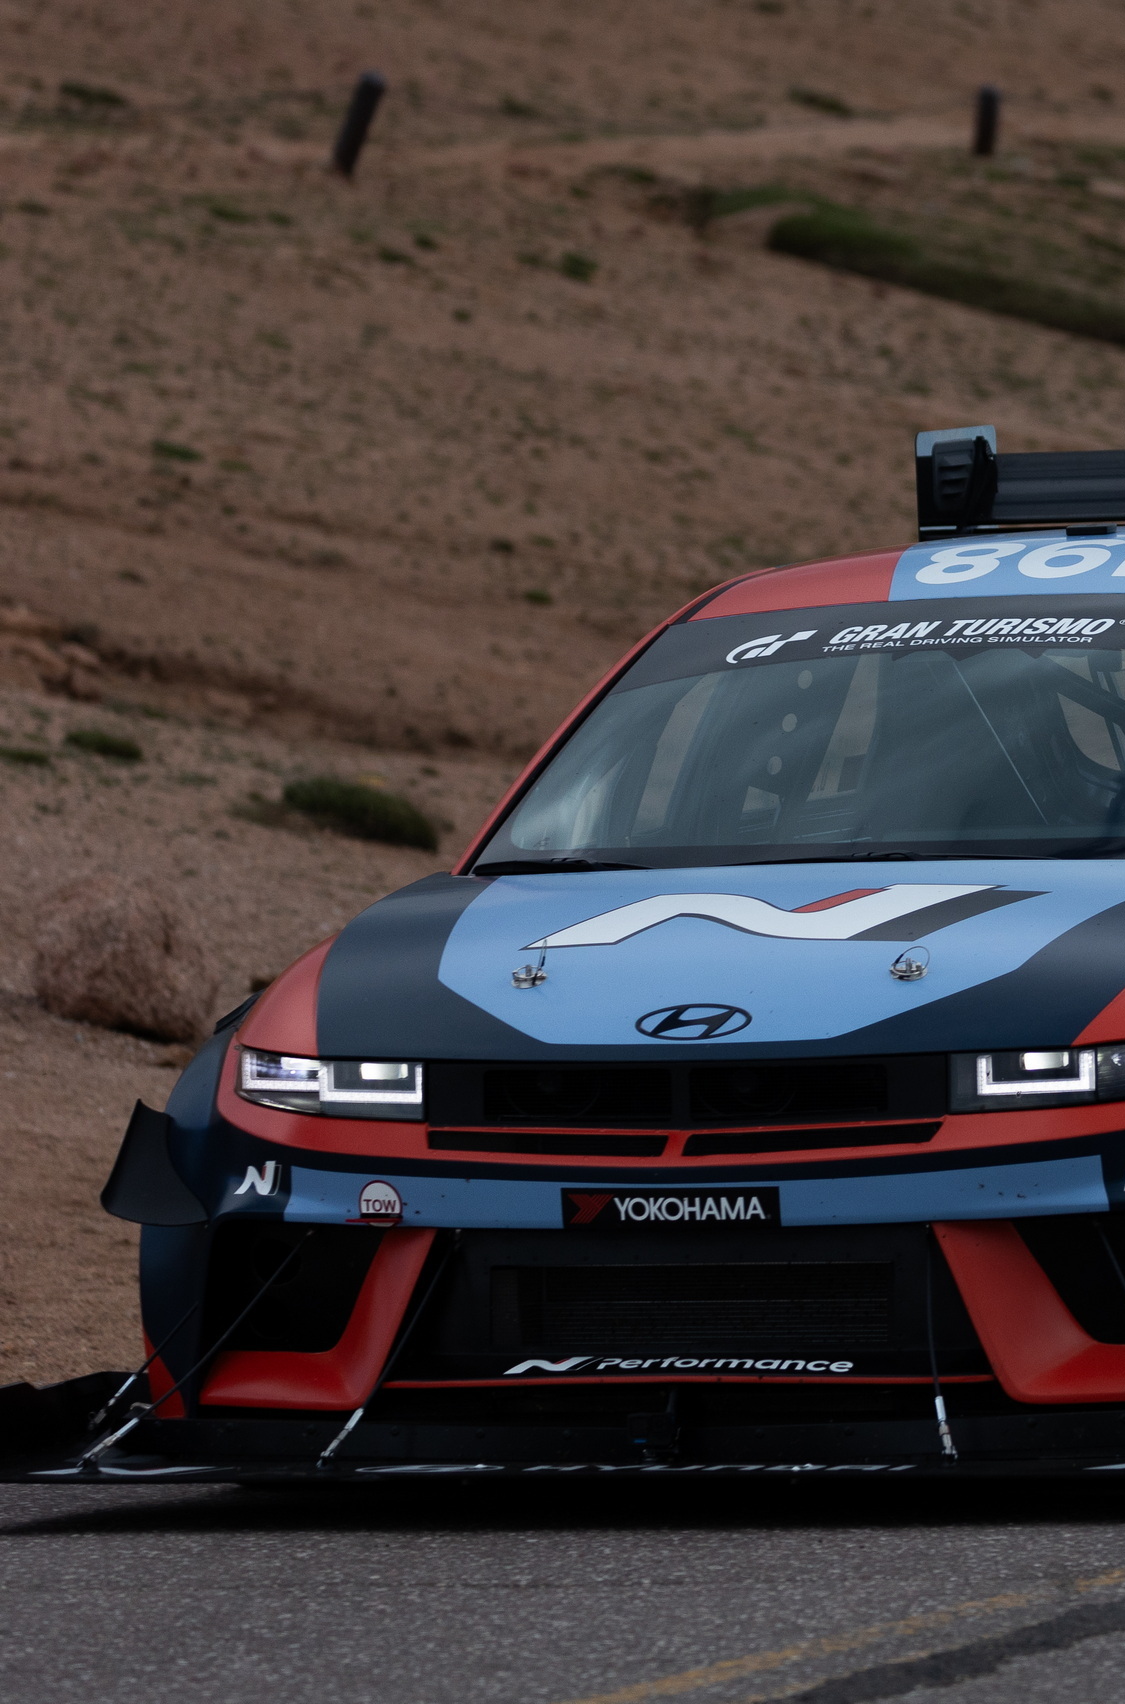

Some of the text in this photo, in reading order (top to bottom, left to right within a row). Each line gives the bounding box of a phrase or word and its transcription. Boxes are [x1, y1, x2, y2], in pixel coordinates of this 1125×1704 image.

[829, 620, 943, 645] GRAN
[822, 635, 1093, 653] THE REAL DRIVING SIMULATOR
[363, 1199, 397, 1213] TOW
[613, 1196, 766, 1221] YOKOHAMA
[597, 1356, 855, 1373] Performance
